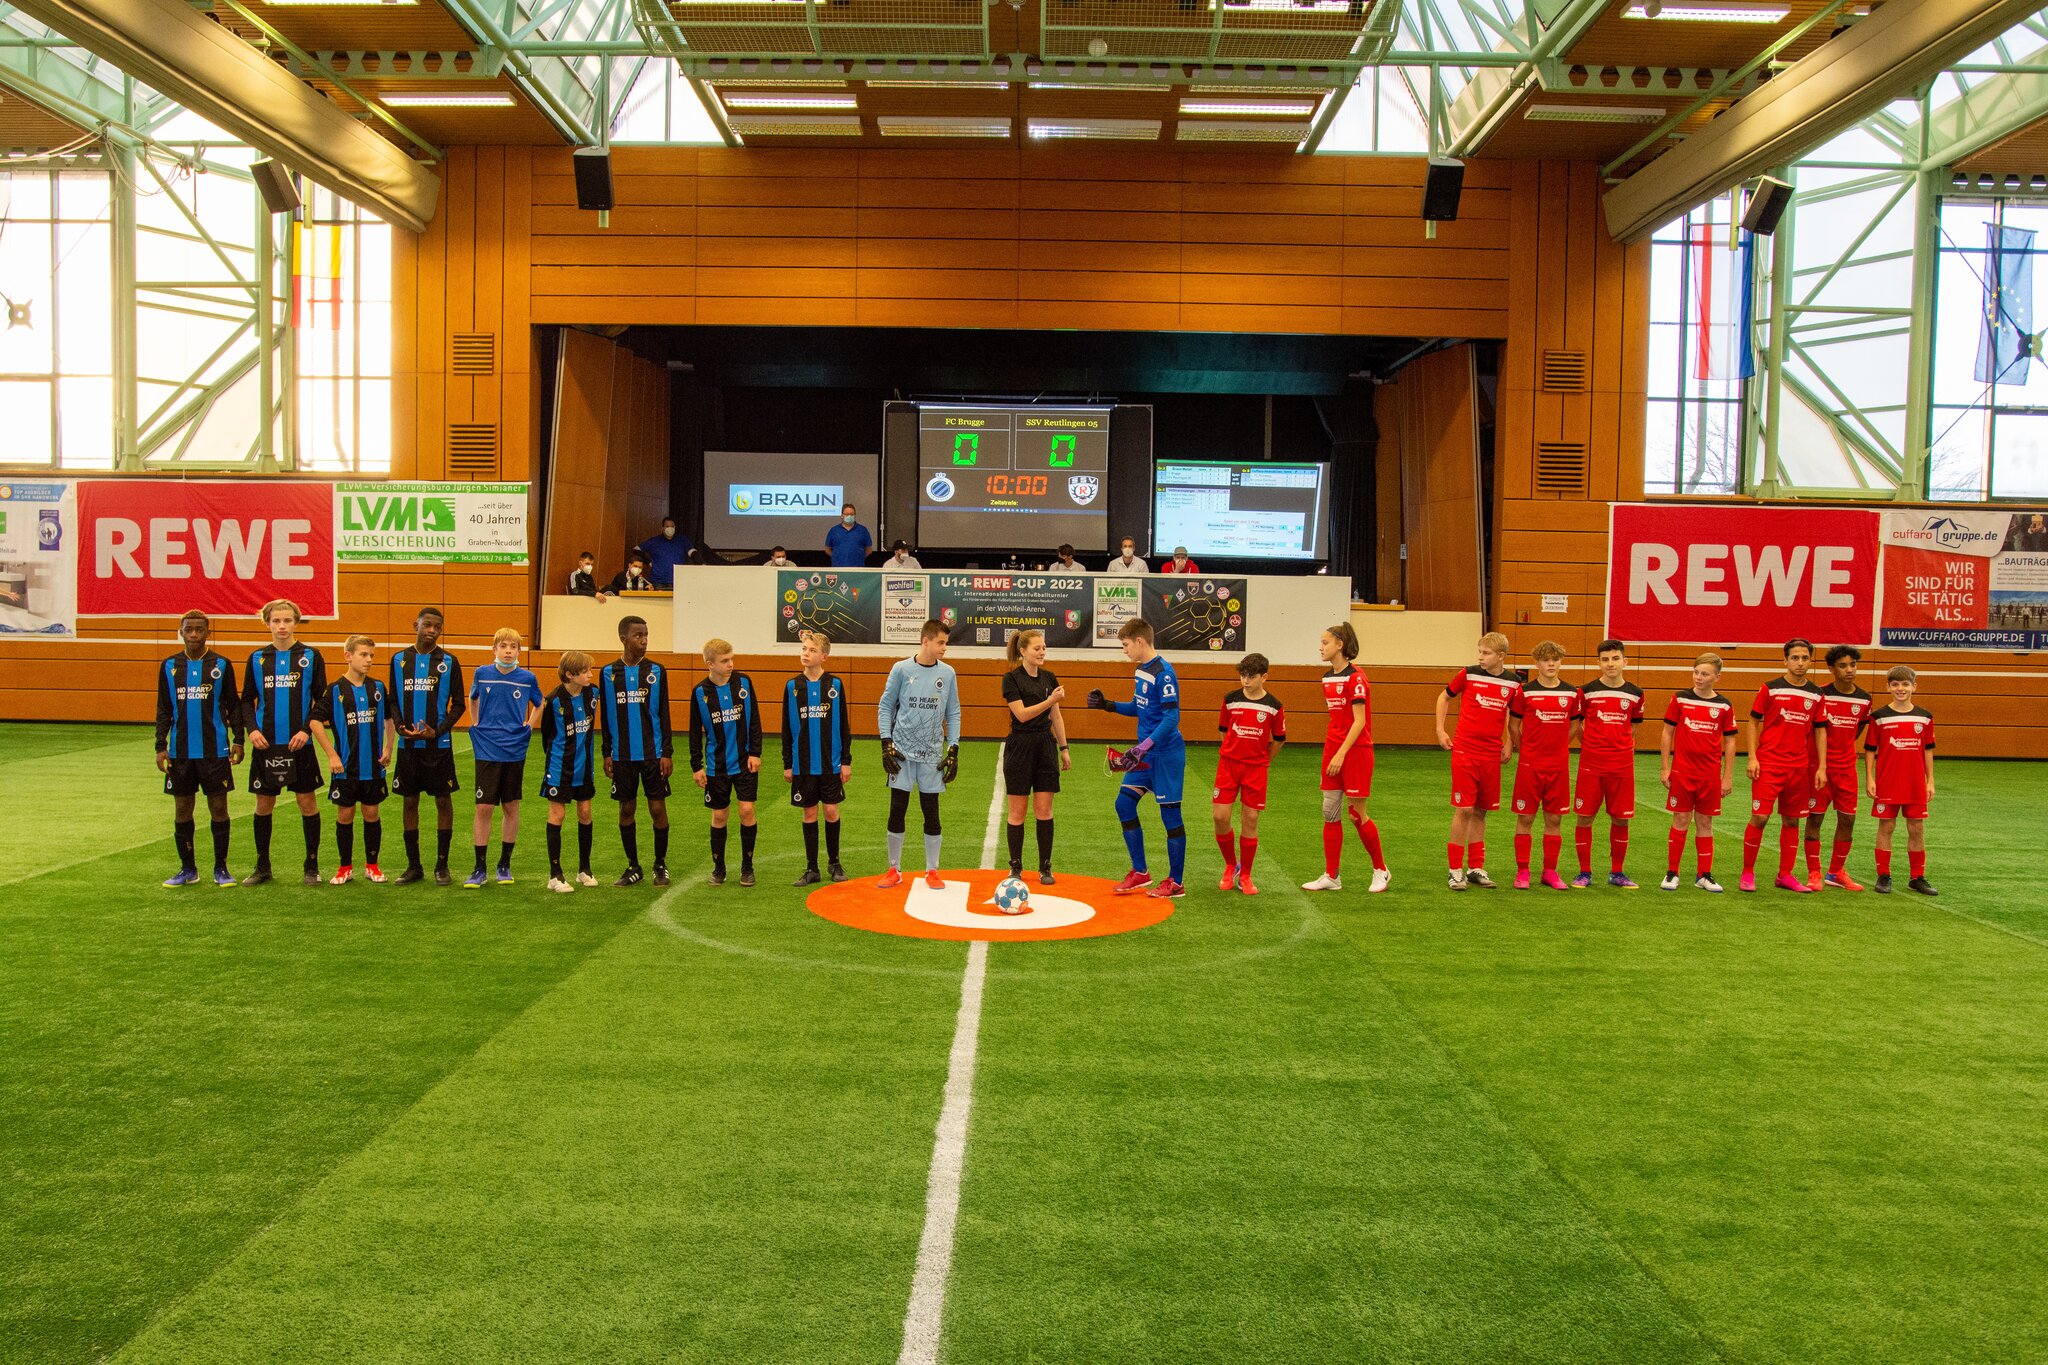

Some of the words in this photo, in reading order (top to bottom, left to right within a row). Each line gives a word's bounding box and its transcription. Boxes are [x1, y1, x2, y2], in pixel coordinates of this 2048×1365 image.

[958, 418, 984, 427] Brugge
[1044, 419, 1086, 428] Reutlingen
[953, 433, 979, 465] 0
[1050, 435, 1077, 467] 0
[986, 475, 1048, 495] 10:00
[760, 493, 836, 506] BRAUN
[343, 496, 417, 531] LVM
[470, 515, 483, 524] 40
[486, 514, 521, 524] Jahren
[343, 535, 456, 548] VERSICHERUNG
[1893, 529, 1932, 539] cuffaro
[1943, 531, 1998, 542] gruppe.de
[95, 518, 314, 580] REWE
[1946, 562, 1974, 574] WIR
[1628, 542, 1854, 608] REWE
[888, 580, 914, 589] wohlfeil
[1050, 579, 1083, 590] 2022
[1905, 577, 1940, 589] SIND
[1945, 575, 1974, 590] FÜR
[1098, 587, 1124, 597] LVM
[1908, 592, 1929, 605] SIE
[1932, 591, 1973, 606] TÄTIG
[975, 617, 1047, 625] LIVE-STREAMING
[1934, 609, 1973, 621] ALS...
[1887, 631, 2025, 642] WWW.CUFFARO-GRUPPE.DE
[722, 708, 740, 716] HEART
[723, 714, 741, 722] GLORY
[265, 759, 293, 767] NXT
